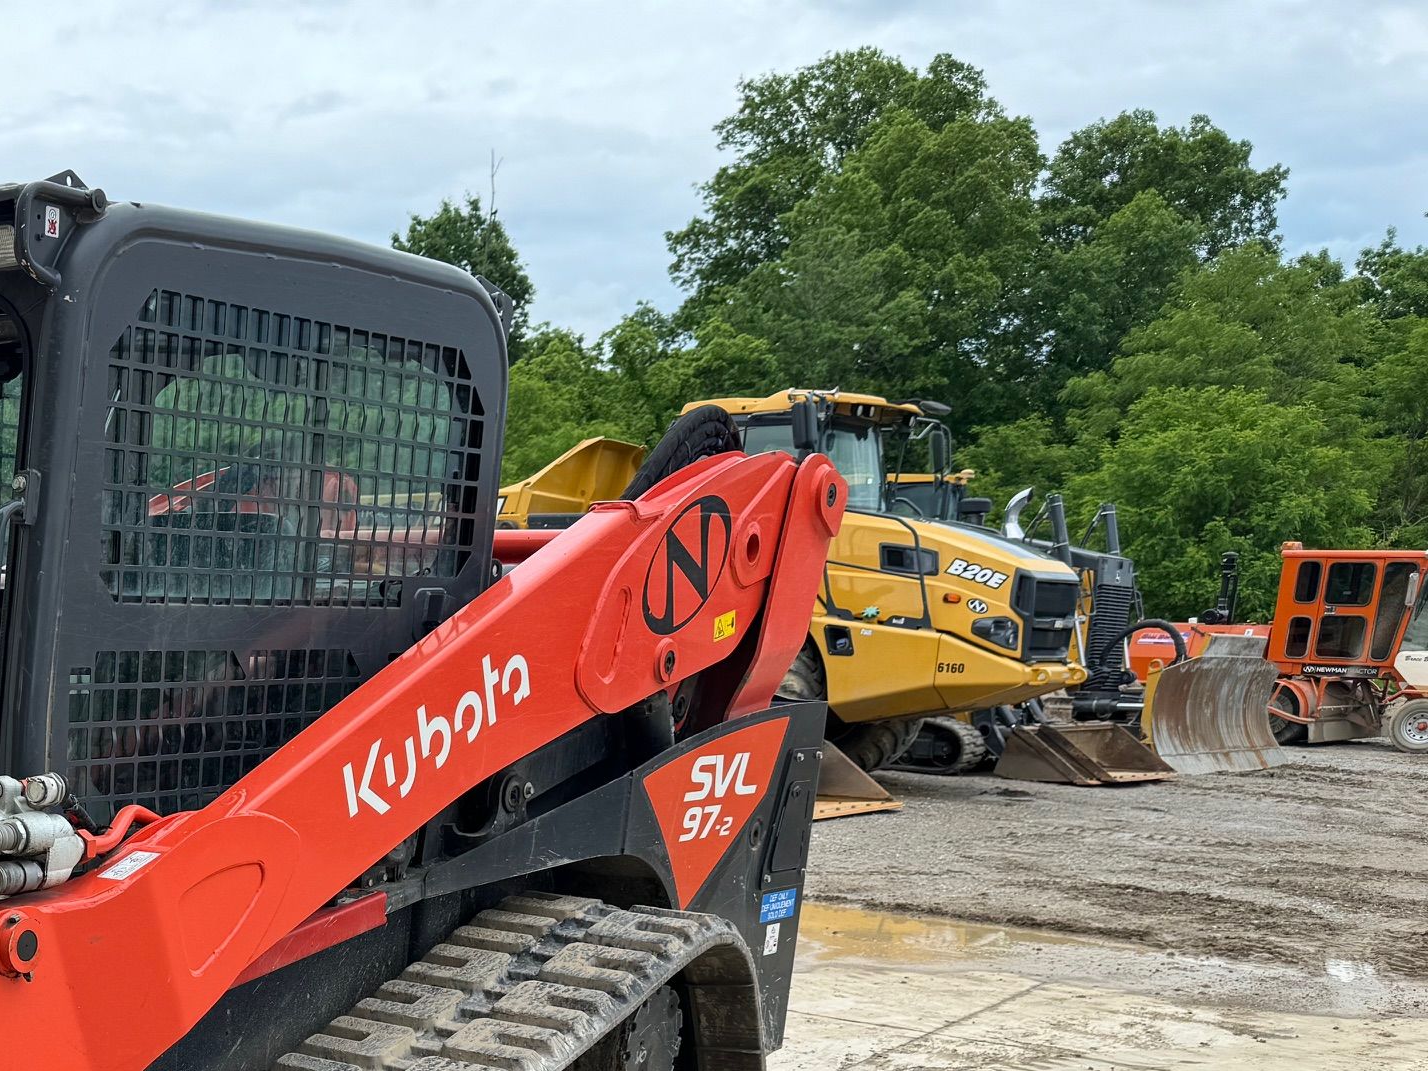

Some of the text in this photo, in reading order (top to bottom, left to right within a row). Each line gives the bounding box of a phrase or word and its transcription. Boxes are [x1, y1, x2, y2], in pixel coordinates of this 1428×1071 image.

[945, 558, 1009, 589] B20E
[937, 662, 965, 674] 6160
[342, 654, 531, 818] Kubota
[683, 752, 757, 802] SVL
[678, 804, 733, 842] 97-2
